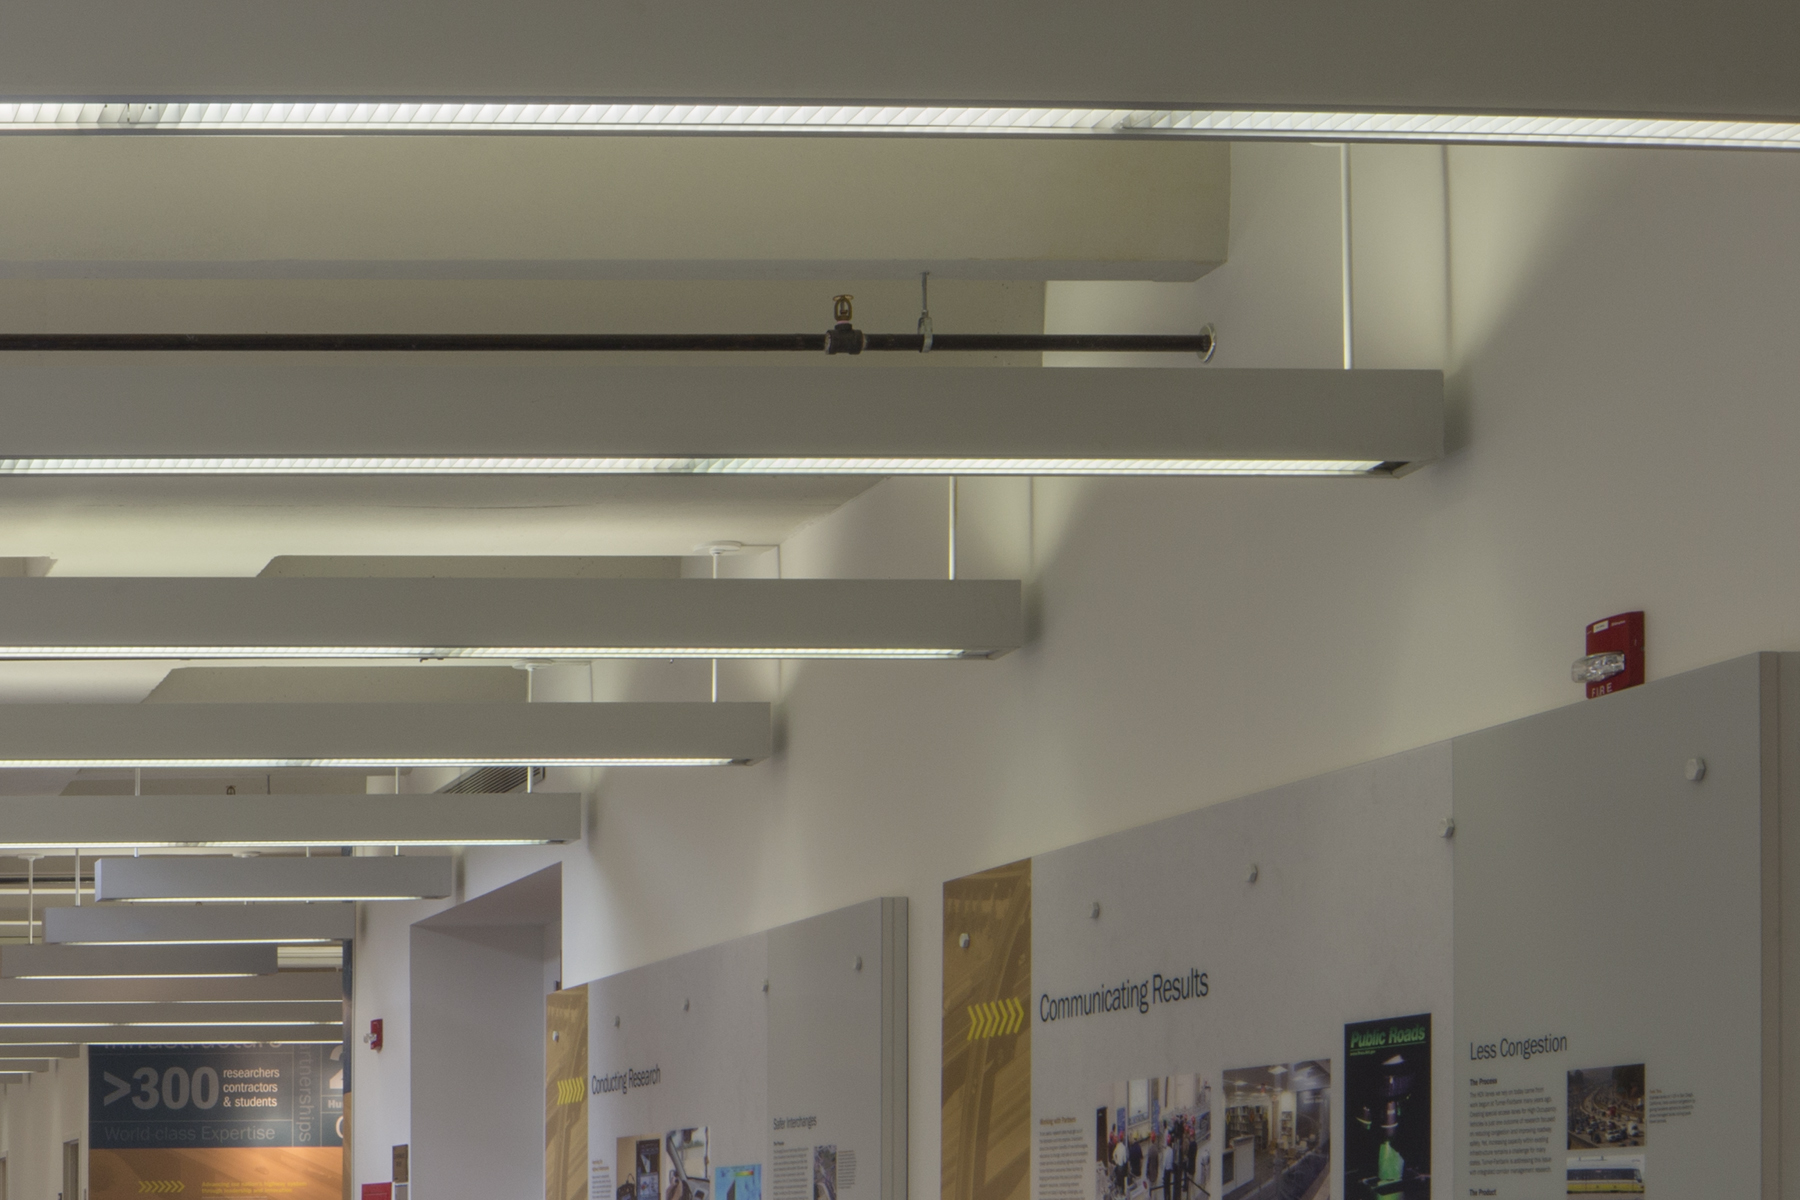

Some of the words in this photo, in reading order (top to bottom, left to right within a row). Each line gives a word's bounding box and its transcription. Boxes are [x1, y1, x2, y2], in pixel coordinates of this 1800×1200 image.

[1591, 682, 1613, 698] FIRE
[1040, 980, 1149, 1022] Communicating
[1153, 967, 1209, 1004] Results
[1350, 1029, 1386, 1048] Public
[1388, 1023, 1425, 1044] Roads
[1470, 1041, 1497, 1061] Less
[1500, 1033, 1568, 1060] Congestion
[223, 1067, 280, 1079] researchers
[591, 1071, 627, 1095] Conducting
[628, 1063, 661, 1089] Research
[103, 1066, 220, 1110] >300
[223, 1082, 278, 1093] contractors
[223, 1096, 232, 1107] &
[234, 1096, 278, 1107] students
[773, 1117, 786, 1130] Safer
[104, 1127, 196, 1140] World-class
[201, 1126, 276, 1142] Expertise
